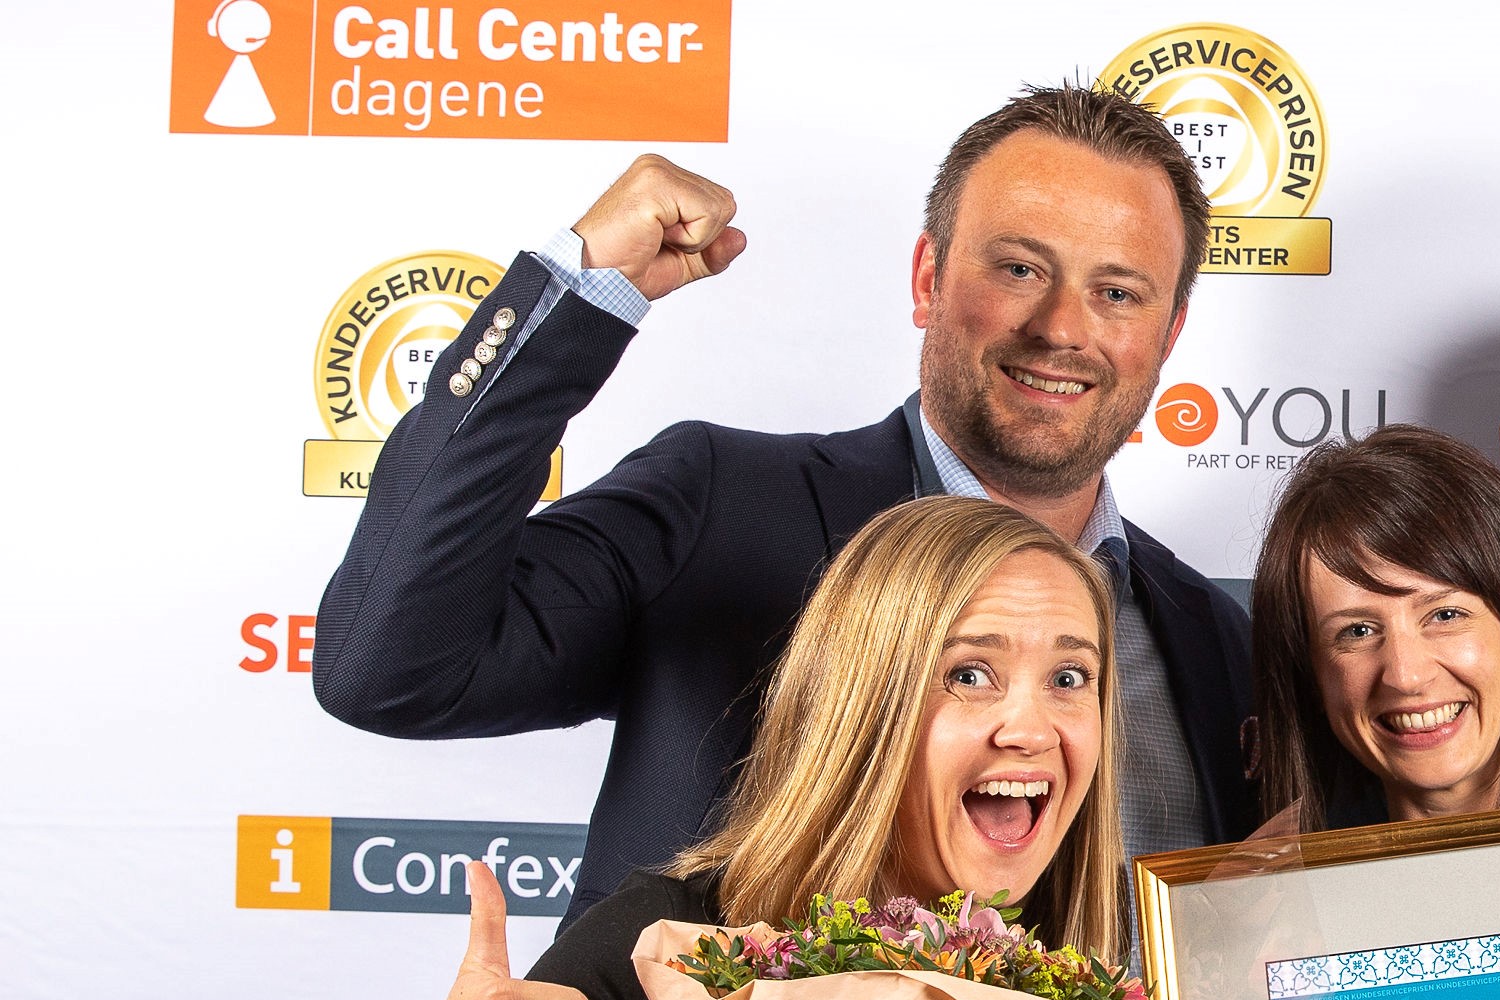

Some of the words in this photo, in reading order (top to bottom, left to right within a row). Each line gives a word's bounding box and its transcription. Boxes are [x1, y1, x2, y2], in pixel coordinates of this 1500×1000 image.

[331, 7, 458, 61] Call
[478, 8, 703, 64] Center-
[330, 66, 545, 131] dagene
[1173, 123, 1228, 137] BEST
[1187, 454, 1230, 468] PART
[1235, 454, 1260, 469] OF
[1351, 984, 1435, 1000] KUNDESERVICEPRISEN
